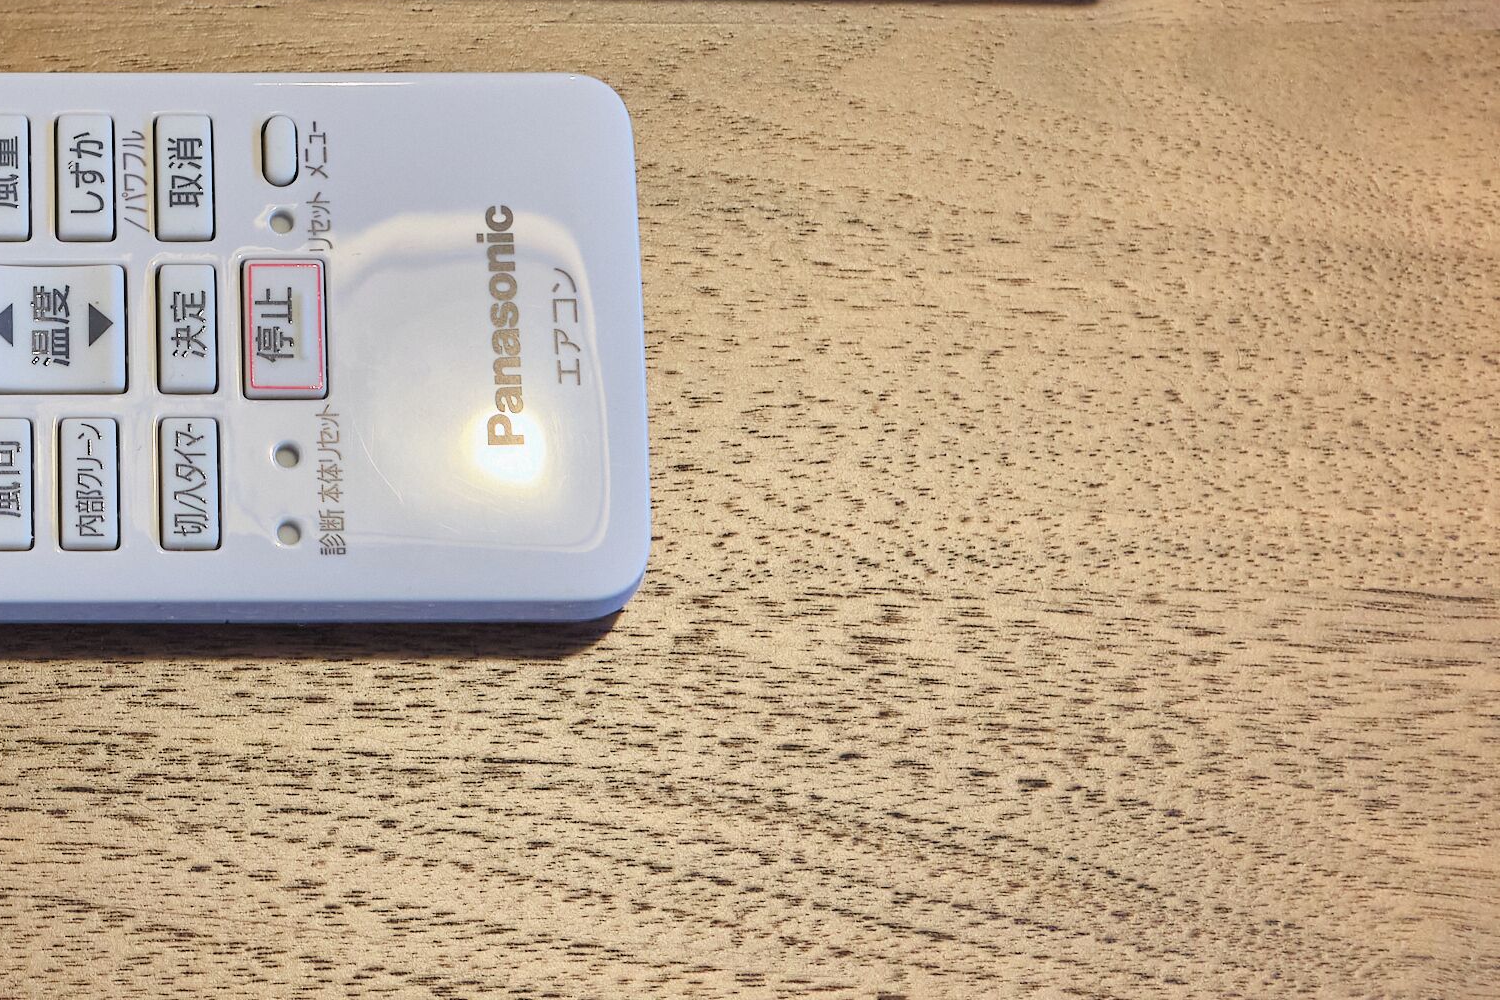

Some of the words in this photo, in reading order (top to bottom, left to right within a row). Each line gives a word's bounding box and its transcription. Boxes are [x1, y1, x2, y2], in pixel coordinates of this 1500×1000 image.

[67, 132, 104, 215] しずか
[167, 137, 204, 208] 取消
[305, 121, 328, 180] メニュー
[307, 191, 332, 252] リセット
[31, 285, 72, 367] 温度
[171, 290, 207, 359] 決定
[255, 287, 295, 363] 停止
[476, 205, 525, 446] Panasonic
[553, 268, 582, 386] エアコン
[75, 423, 106, 537] 内部クリーン
[173, 423, 208, 536] 切/入タイマー
[315, 404, 343, 503] 本体リセット
[318, 510, 347, 555] 診断
